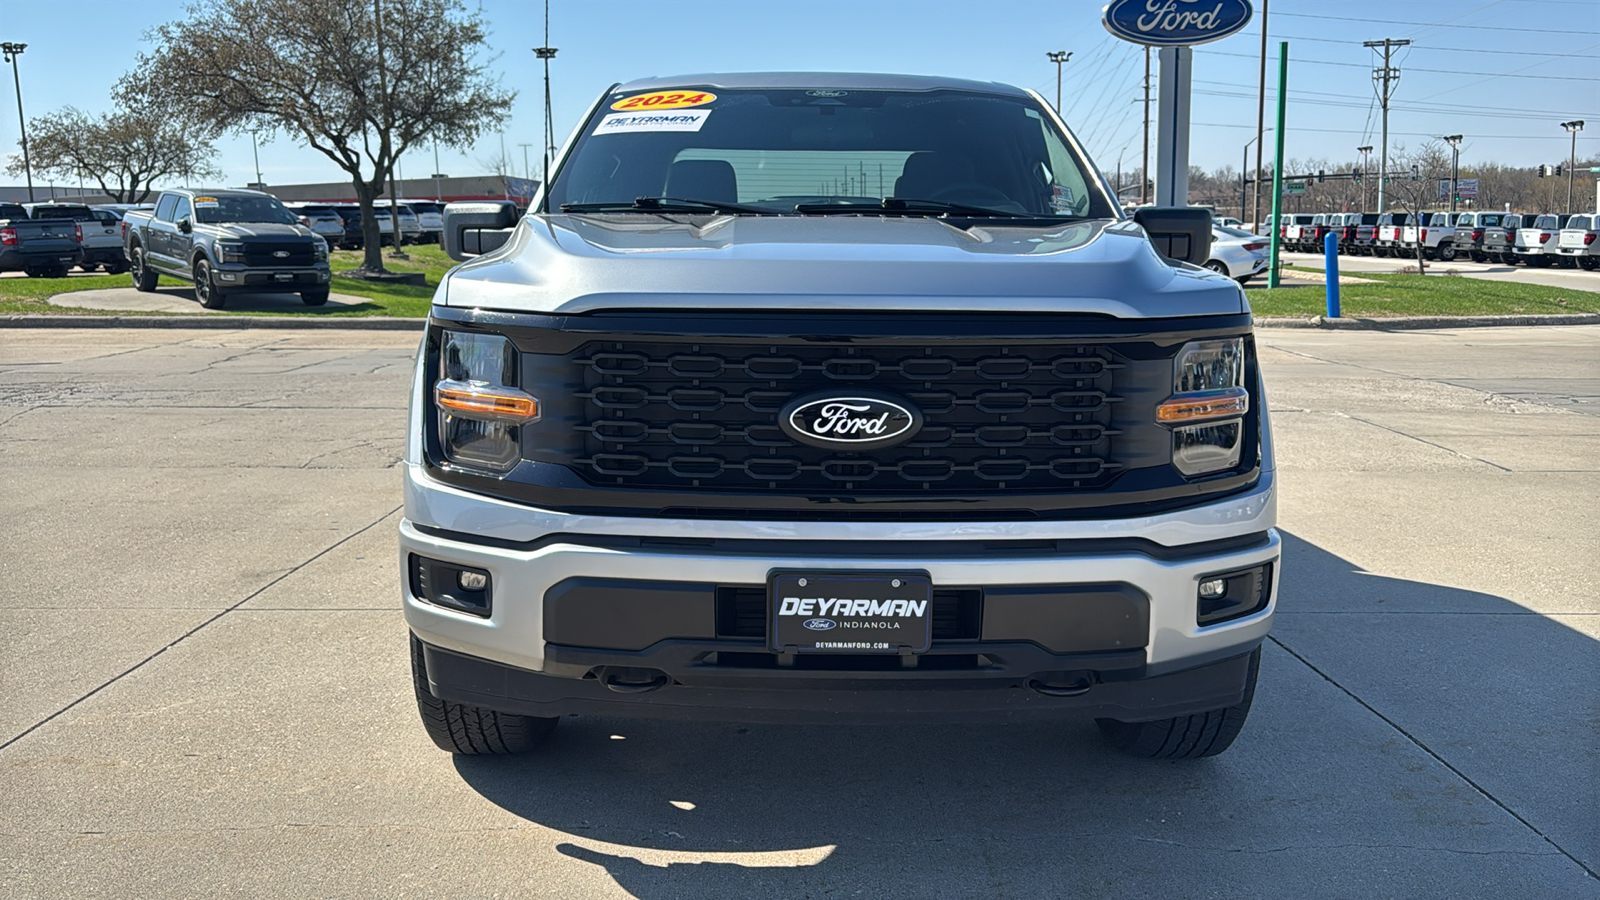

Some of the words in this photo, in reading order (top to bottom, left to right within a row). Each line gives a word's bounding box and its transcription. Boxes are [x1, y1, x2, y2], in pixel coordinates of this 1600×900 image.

[1137, 0, 1223, 31] Ford
[619, 94, 707, 109] 2024
[606, 116, 701, 125] DEYARMAN
[813, 403, 889, 434] Ford
[779, 597, 927, 617] DEYARMAN
[810, 620, 830, 629] Ford
[839, 621, 900, 629] INDIANOLA
